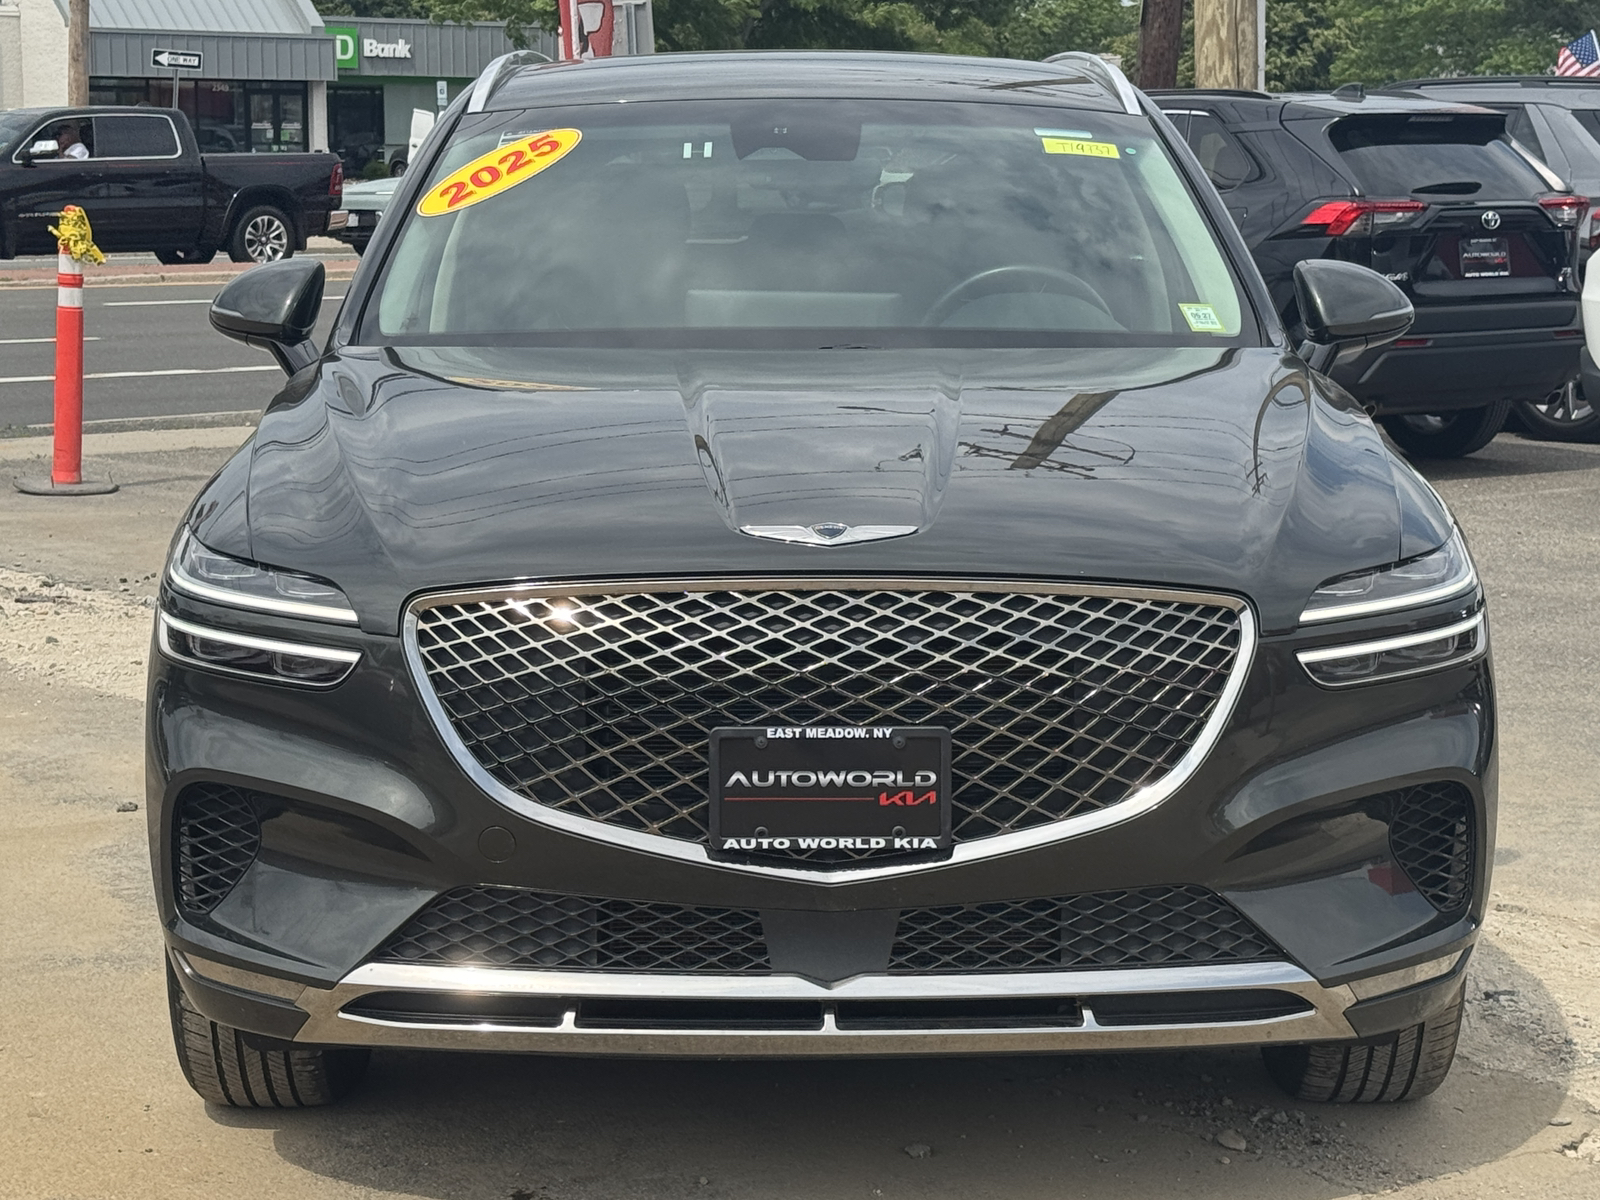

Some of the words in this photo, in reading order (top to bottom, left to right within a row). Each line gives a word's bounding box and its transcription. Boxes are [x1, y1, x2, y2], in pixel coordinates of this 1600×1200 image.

[336, 34, 354, 60] D
[363, 38, 412, 58] Bank
[439, 134, 563, 208] 2025
[766, 728, 801, 738] EAST
[873, 728, 893, 738] NY
[724, 770, 937, 788] AUTOWORLD
[879, 791, 937, 806] KIA
[723, 838, 791, 849] AUTO
[799, 838, 886, 849] WORLD
[894, 838, 937, 849] KIA
